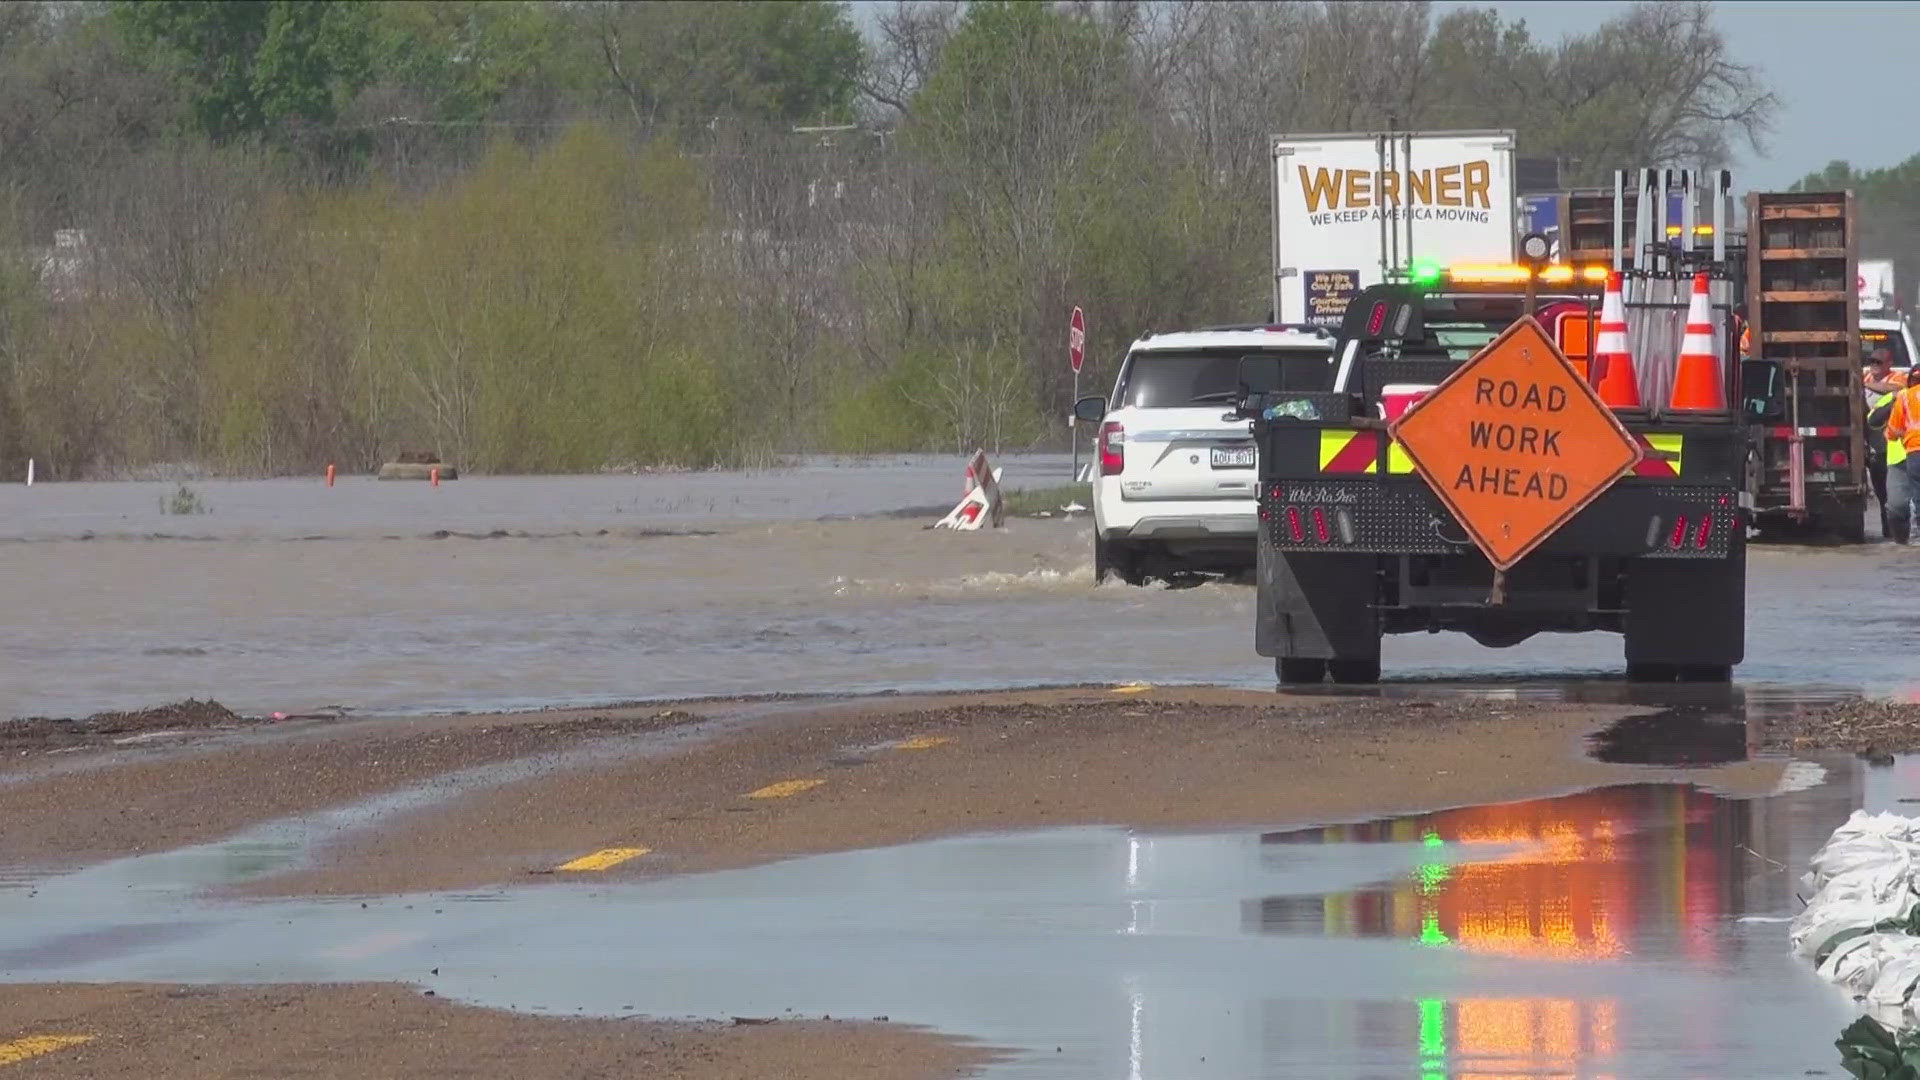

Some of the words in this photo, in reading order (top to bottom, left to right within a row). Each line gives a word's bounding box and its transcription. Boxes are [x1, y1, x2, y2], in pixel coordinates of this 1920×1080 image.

[1298, 160, 1491, 213] WERNER
[1310, 213, 1331, 226] WE
[1334, 209, 1368, 223] KEEP
[1436, 209, 1489, 224] MOVING
[1476, 378, 1566, 412] ROAD
[1470, 421, 1561, 457] WORK
[1454, 464, 1567, 500] AHEAD
